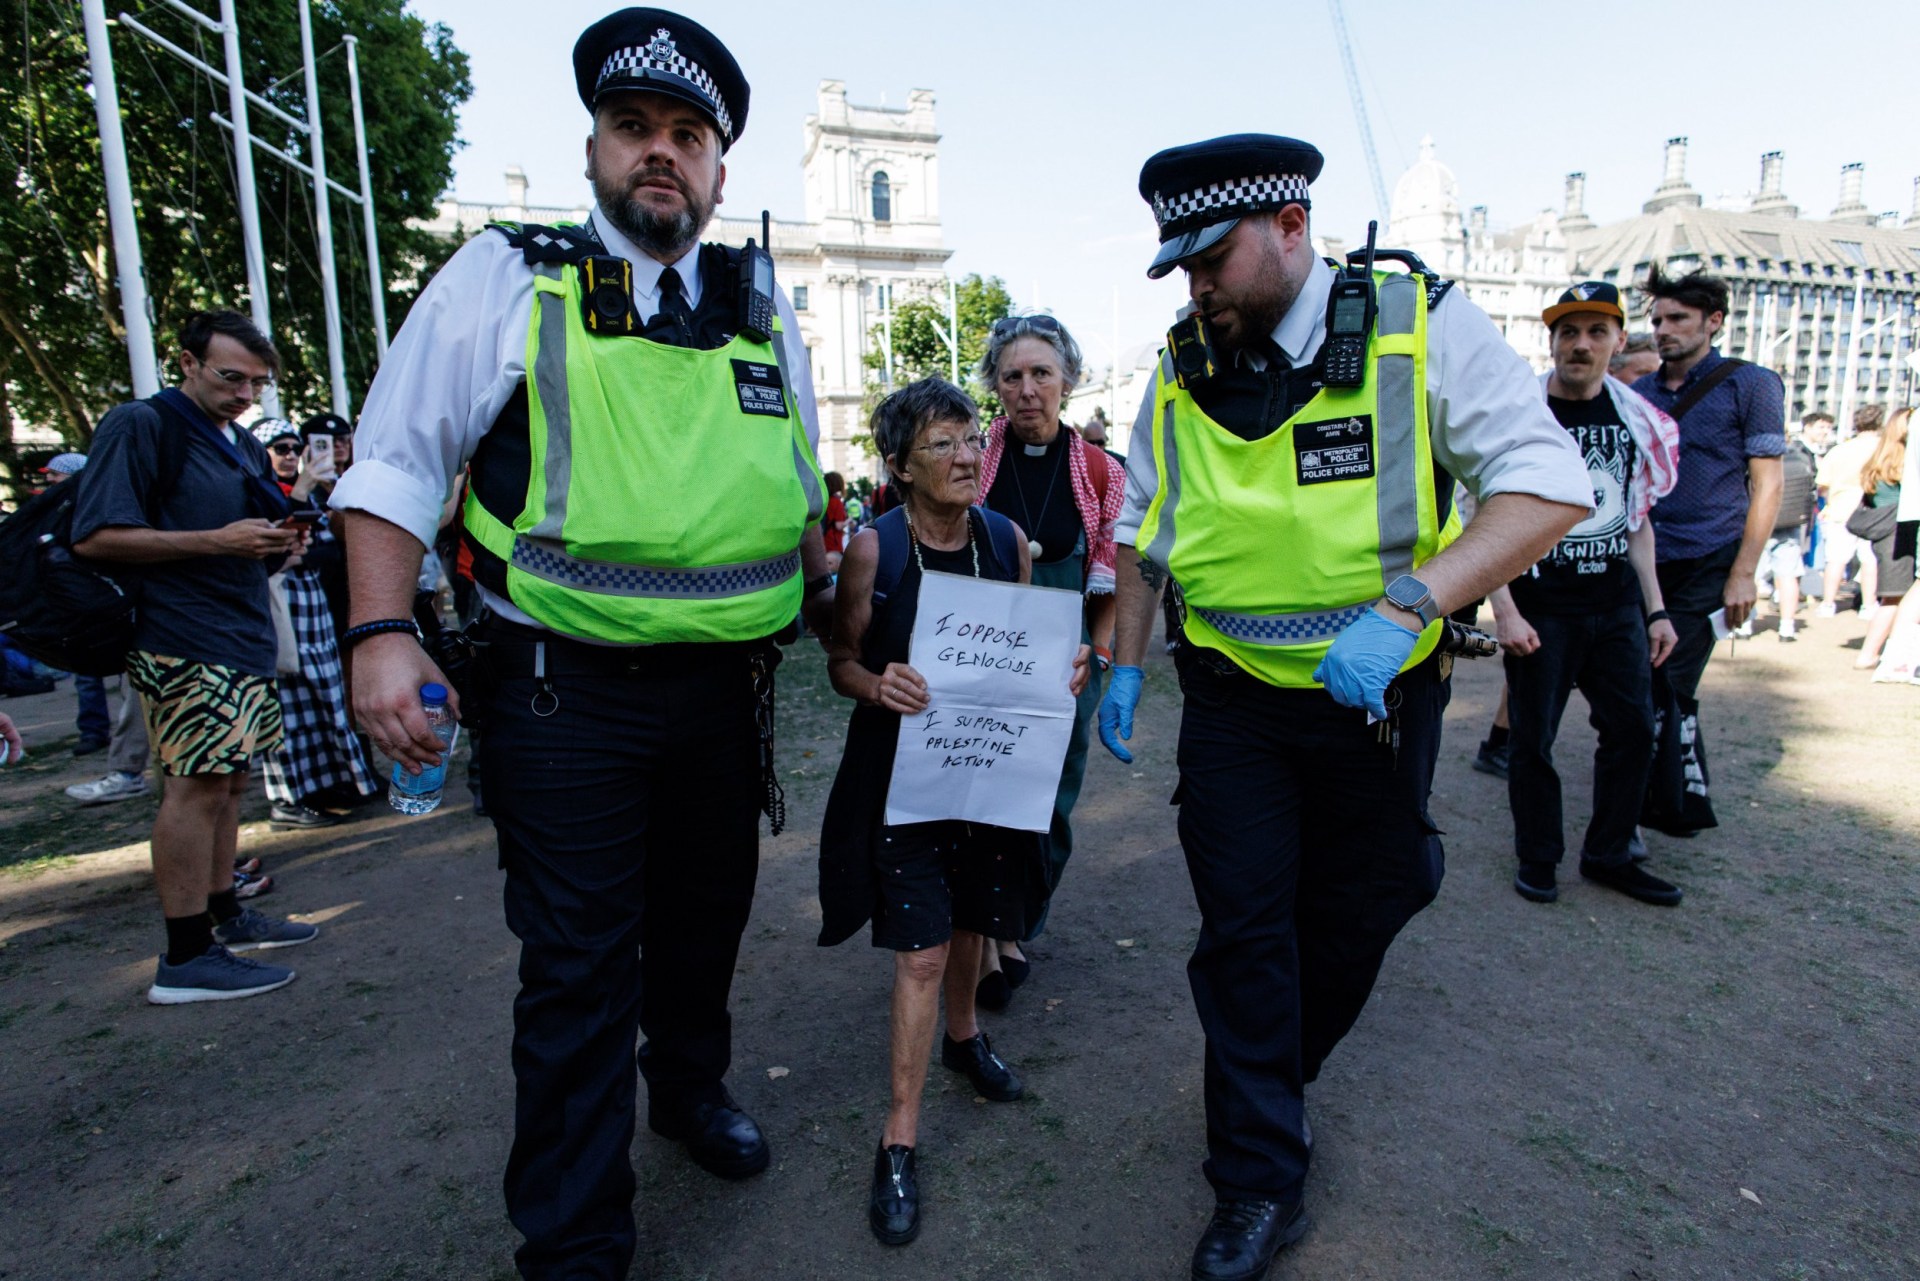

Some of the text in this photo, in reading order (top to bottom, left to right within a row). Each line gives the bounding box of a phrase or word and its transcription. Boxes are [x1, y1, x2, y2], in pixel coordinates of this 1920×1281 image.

[743, 401, 784, 413] POLICE OFFICER
[1317, 422, 1348, 432] CONSTABLE
[1324, 447, 1364, 457] METROPOLITAN
[1330, 453, 1359, 463] POLICE
[1303, 464, 1370, 479] POLICE OFFICER
[1543, 538, 1628, 560] IGNIDAD
[936, 612, 1029, 648] I OPPOSE
[937, 647, 1036, 675] GENOCIDE
[923, 710, 1029, 738] I SUPPORT
[926, 737, 1016, 756] PALESTINE
[941, 753, 996, 769] ACTION
